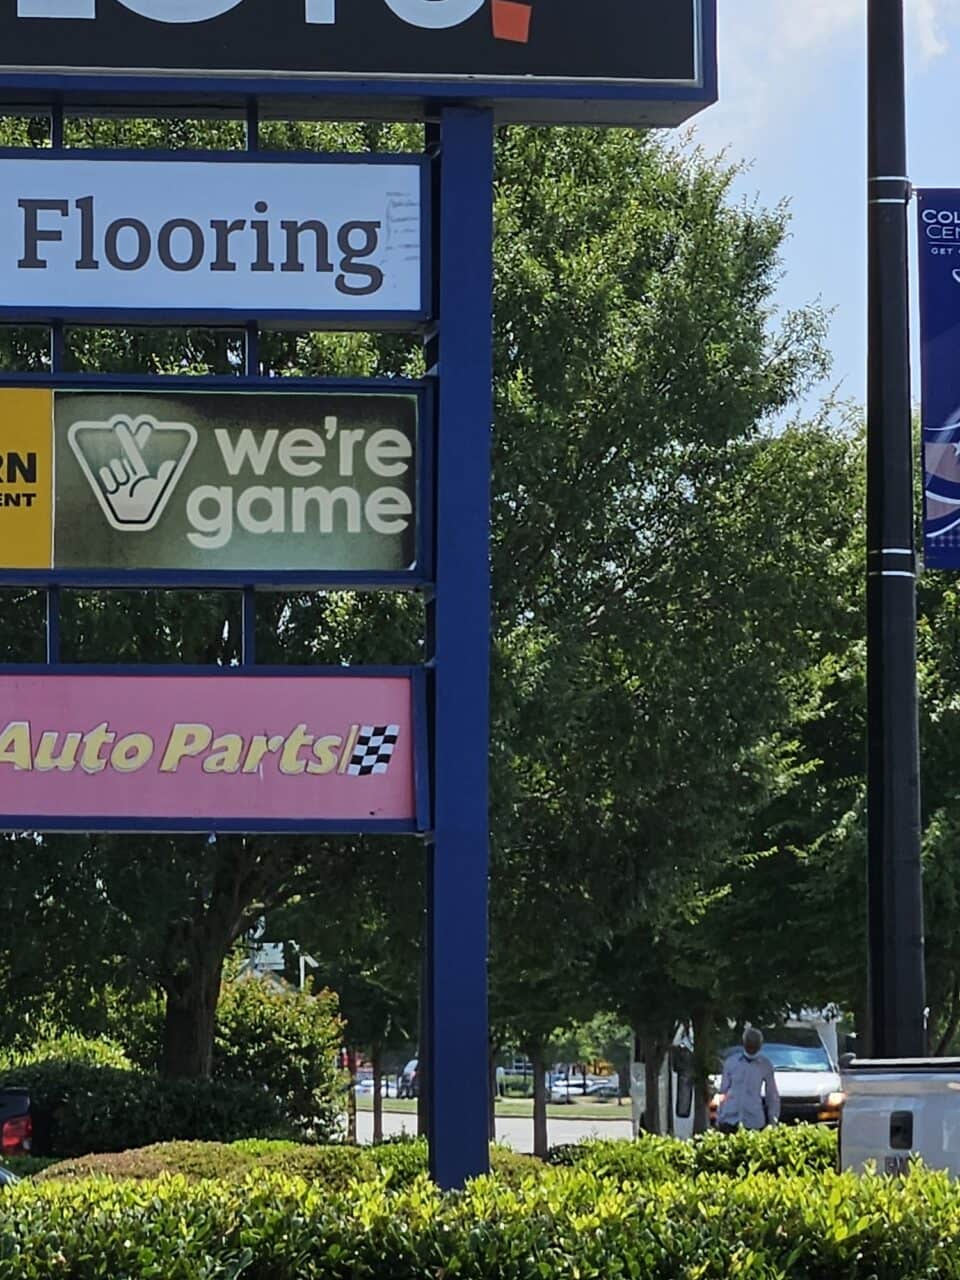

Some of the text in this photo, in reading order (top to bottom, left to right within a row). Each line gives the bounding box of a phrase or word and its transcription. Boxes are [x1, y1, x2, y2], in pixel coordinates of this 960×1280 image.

[16, 195, 384, 295] Flooring
[214, 416, 413, 477] we're
[186, 484, 413, 549] game
[160, 723, 343, 776] Parts
